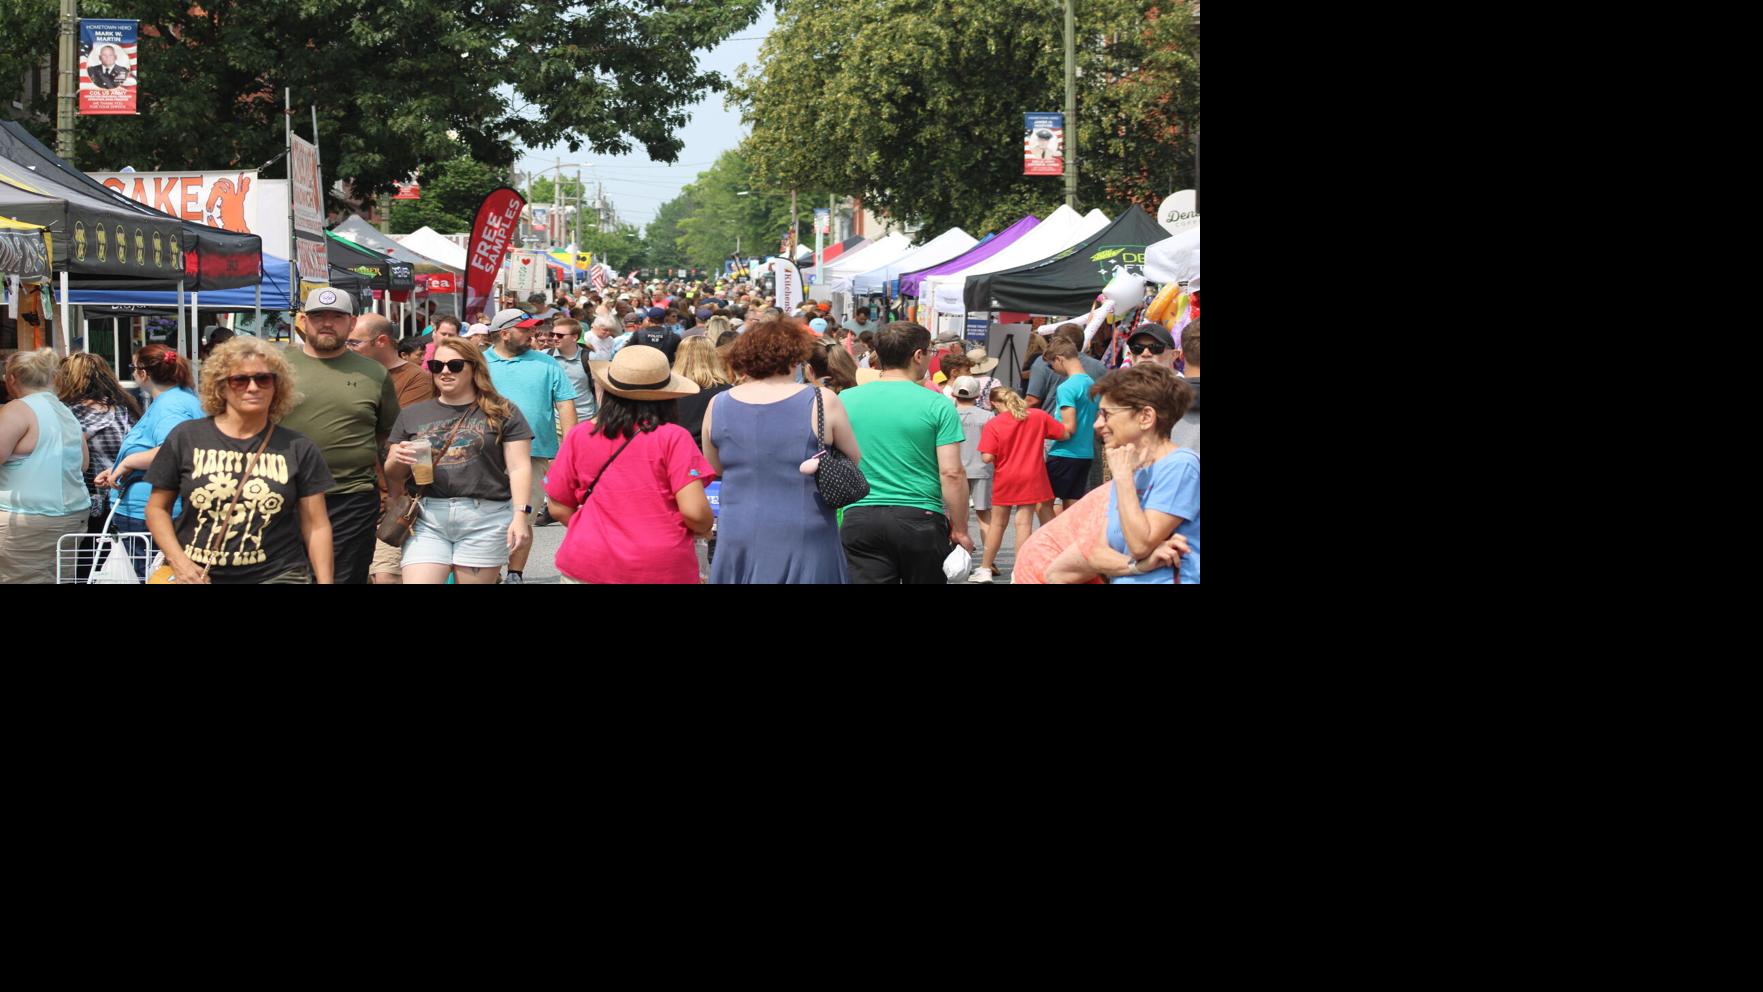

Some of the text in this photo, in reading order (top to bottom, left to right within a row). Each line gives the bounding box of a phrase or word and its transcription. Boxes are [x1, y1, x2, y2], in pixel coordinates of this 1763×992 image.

[471, 211, 502, 270] FREE
[484, 198, 520, 275] SAMPLES
[191, 447, 243, 480] HAPPY
[184, 544, 267, 567] HAPPY LIFE
